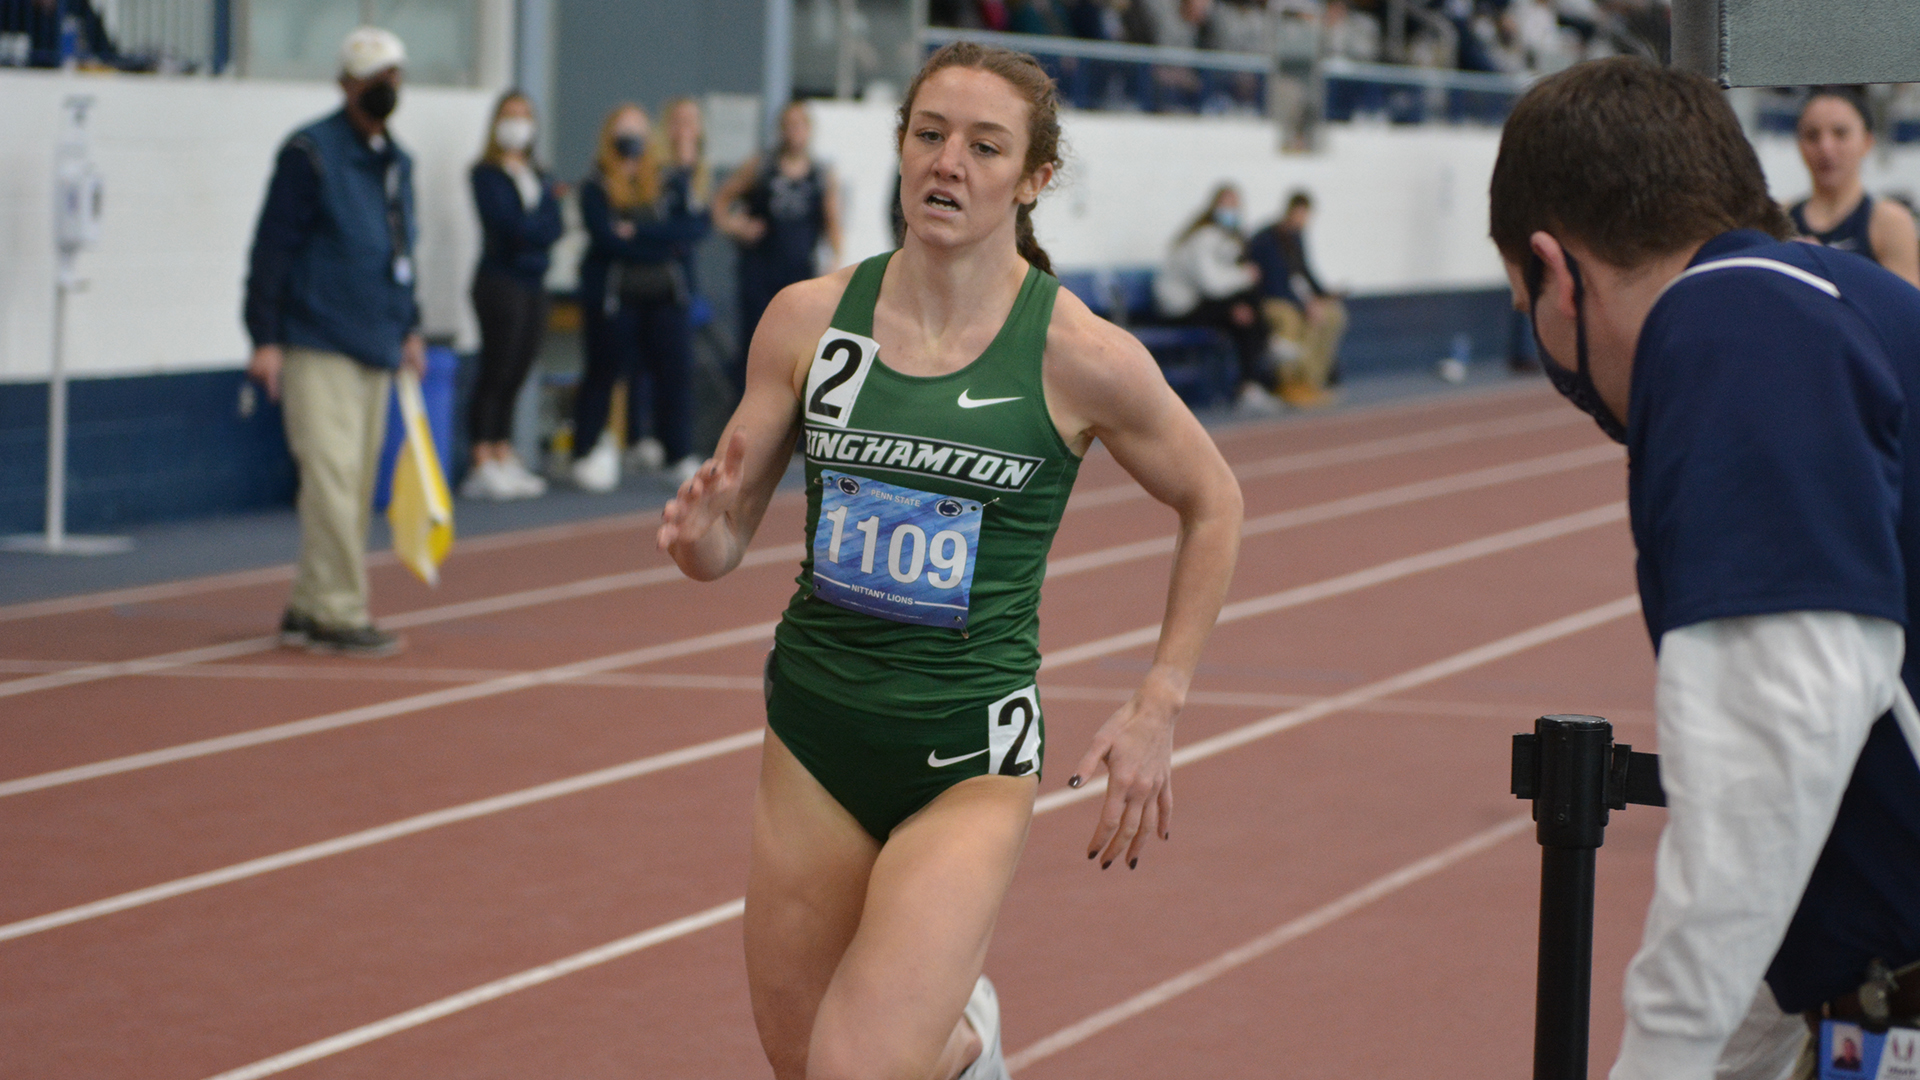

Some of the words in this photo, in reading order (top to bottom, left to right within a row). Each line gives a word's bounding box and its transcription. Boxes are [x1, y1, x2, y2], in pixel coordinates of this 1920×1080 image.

[808, 338, 863, 419] 2
[871, 489, 893, 499] PENN
[895, 494, 921, 507] STATE
[826, 505, 968, 589] 1109
[851, 584, 885, 599] NITTANY
[886, 593, 914, 605] LIONS
[998, 696, 1034, 777] 2
